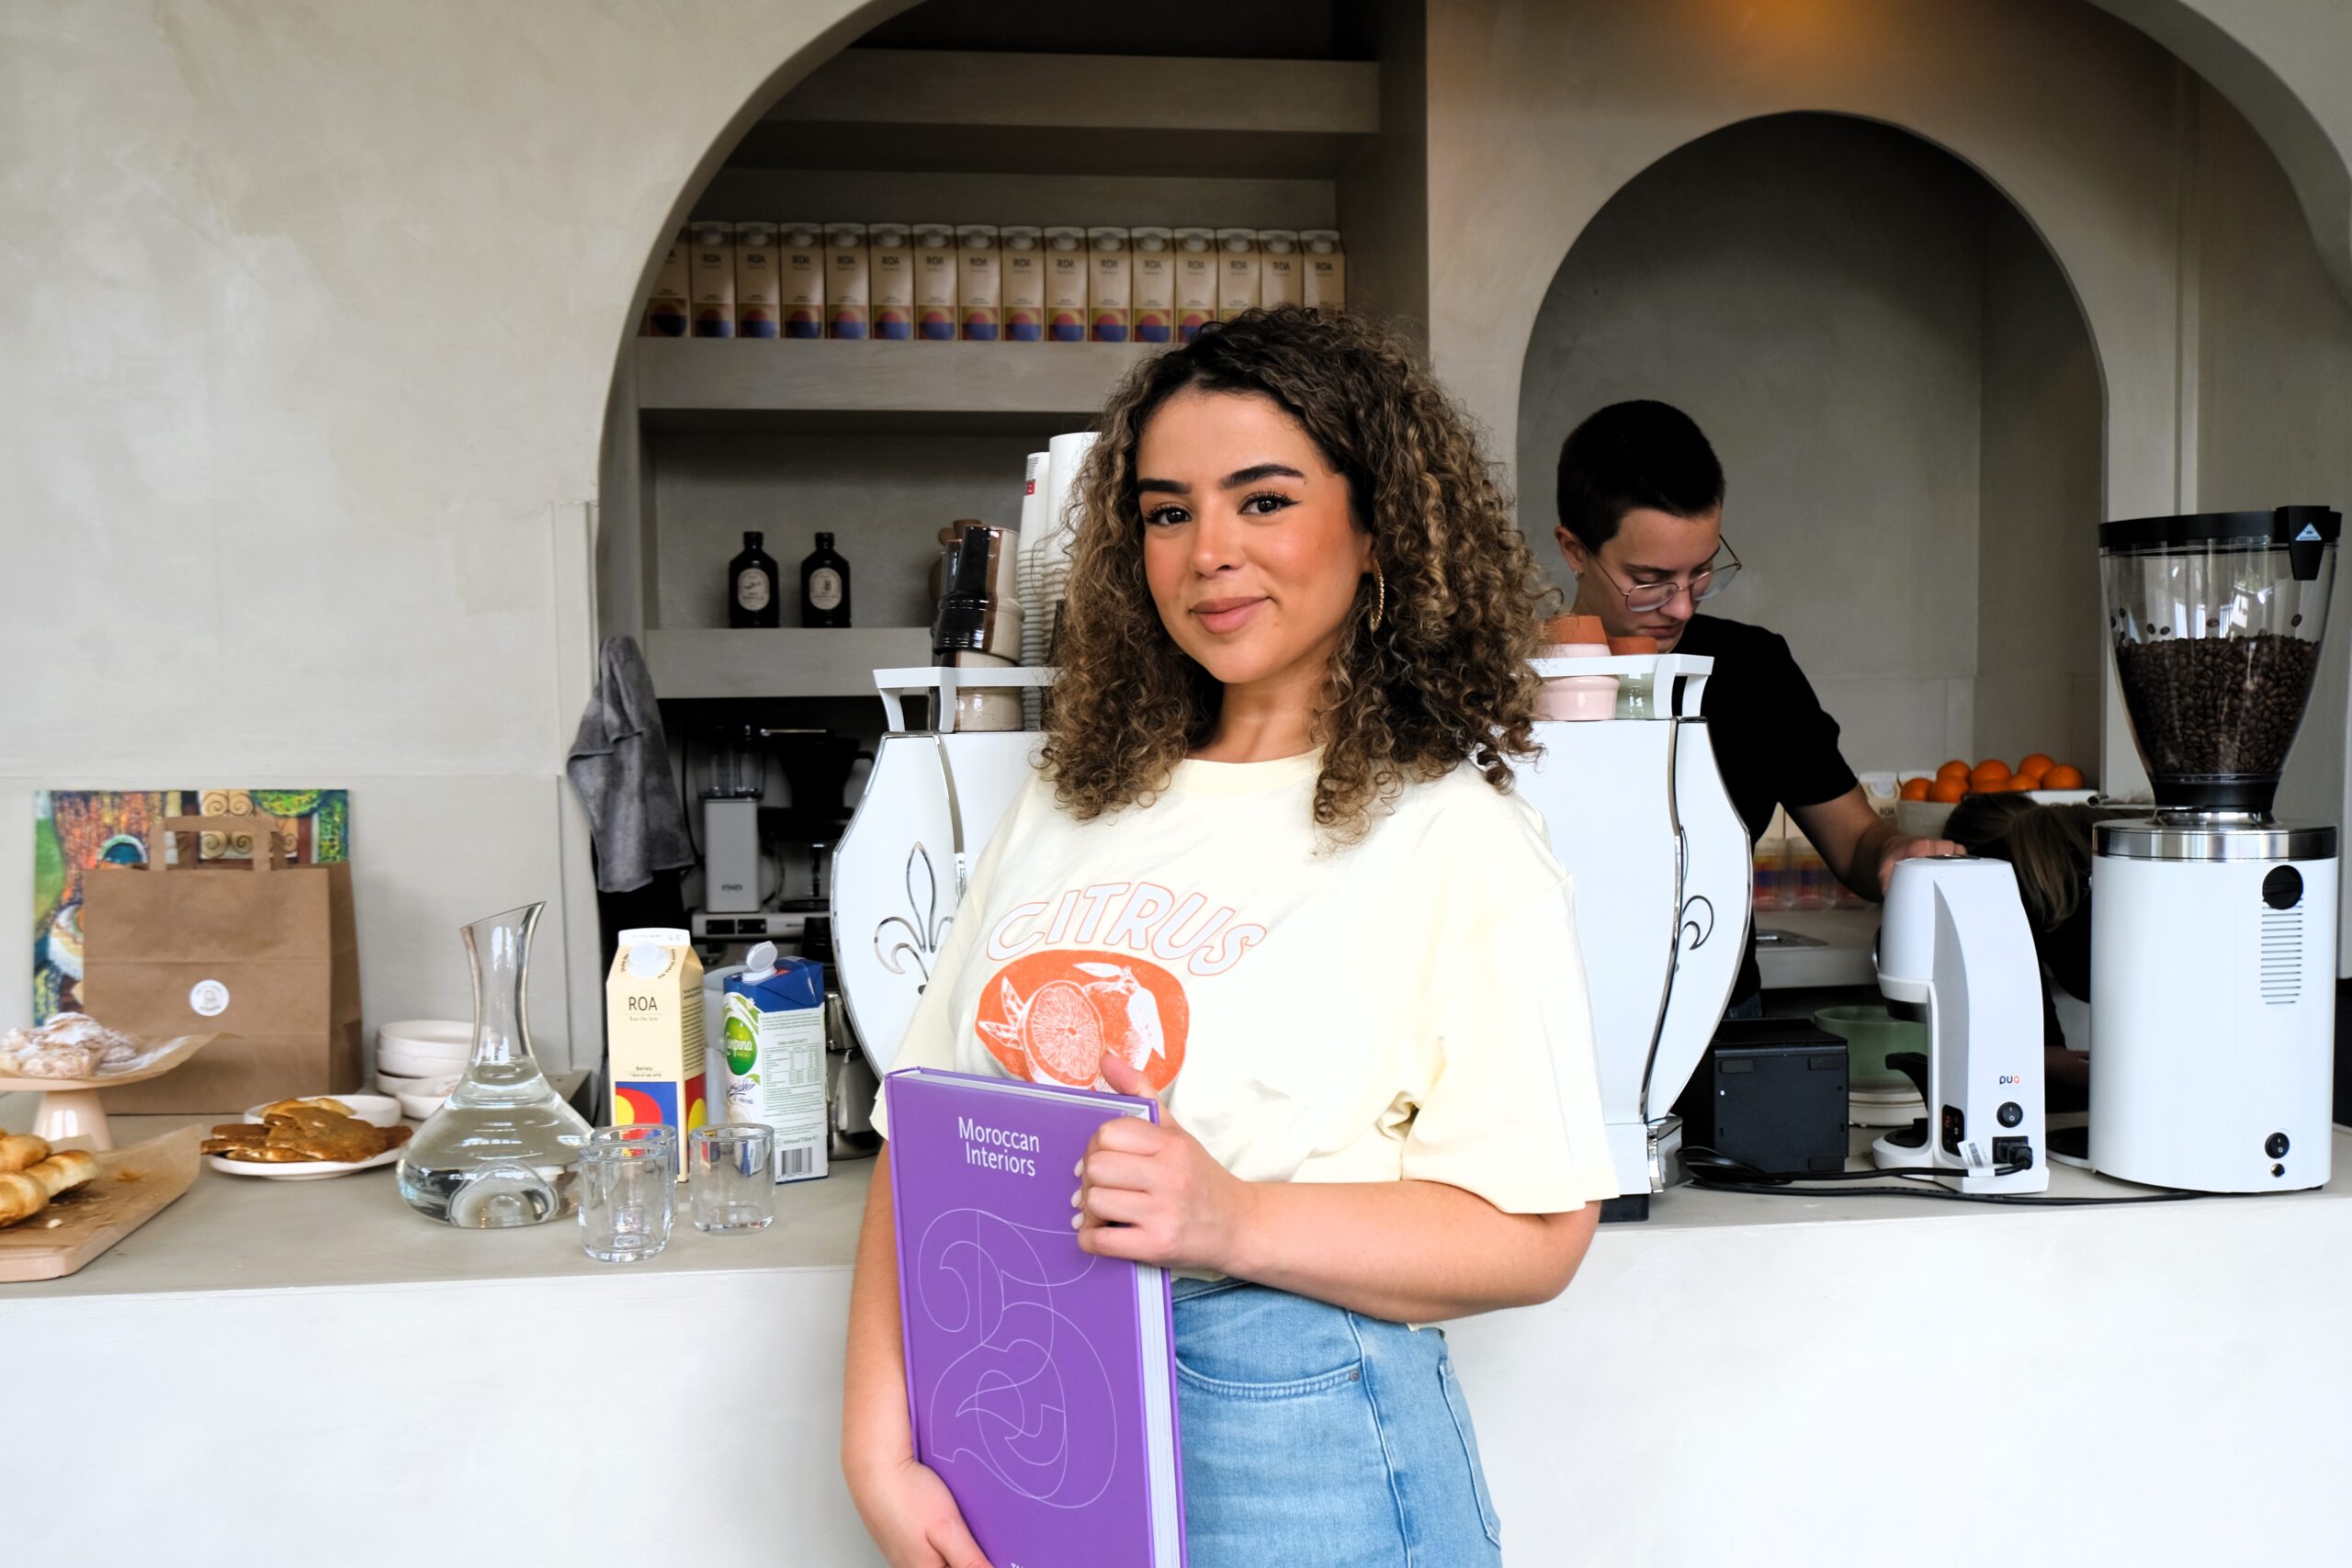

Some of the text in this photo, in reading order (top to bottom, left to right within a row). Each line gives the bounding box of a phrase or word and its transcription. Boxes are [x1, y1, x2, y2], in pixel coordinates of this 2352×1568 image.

[987, 882, 1267, 976] CITRUS
[628, 996, 658, 1010] ROA
[958, 1116, 1040, 1153] Moroccan
[966, 1141, 1035, 1177] Interiors
